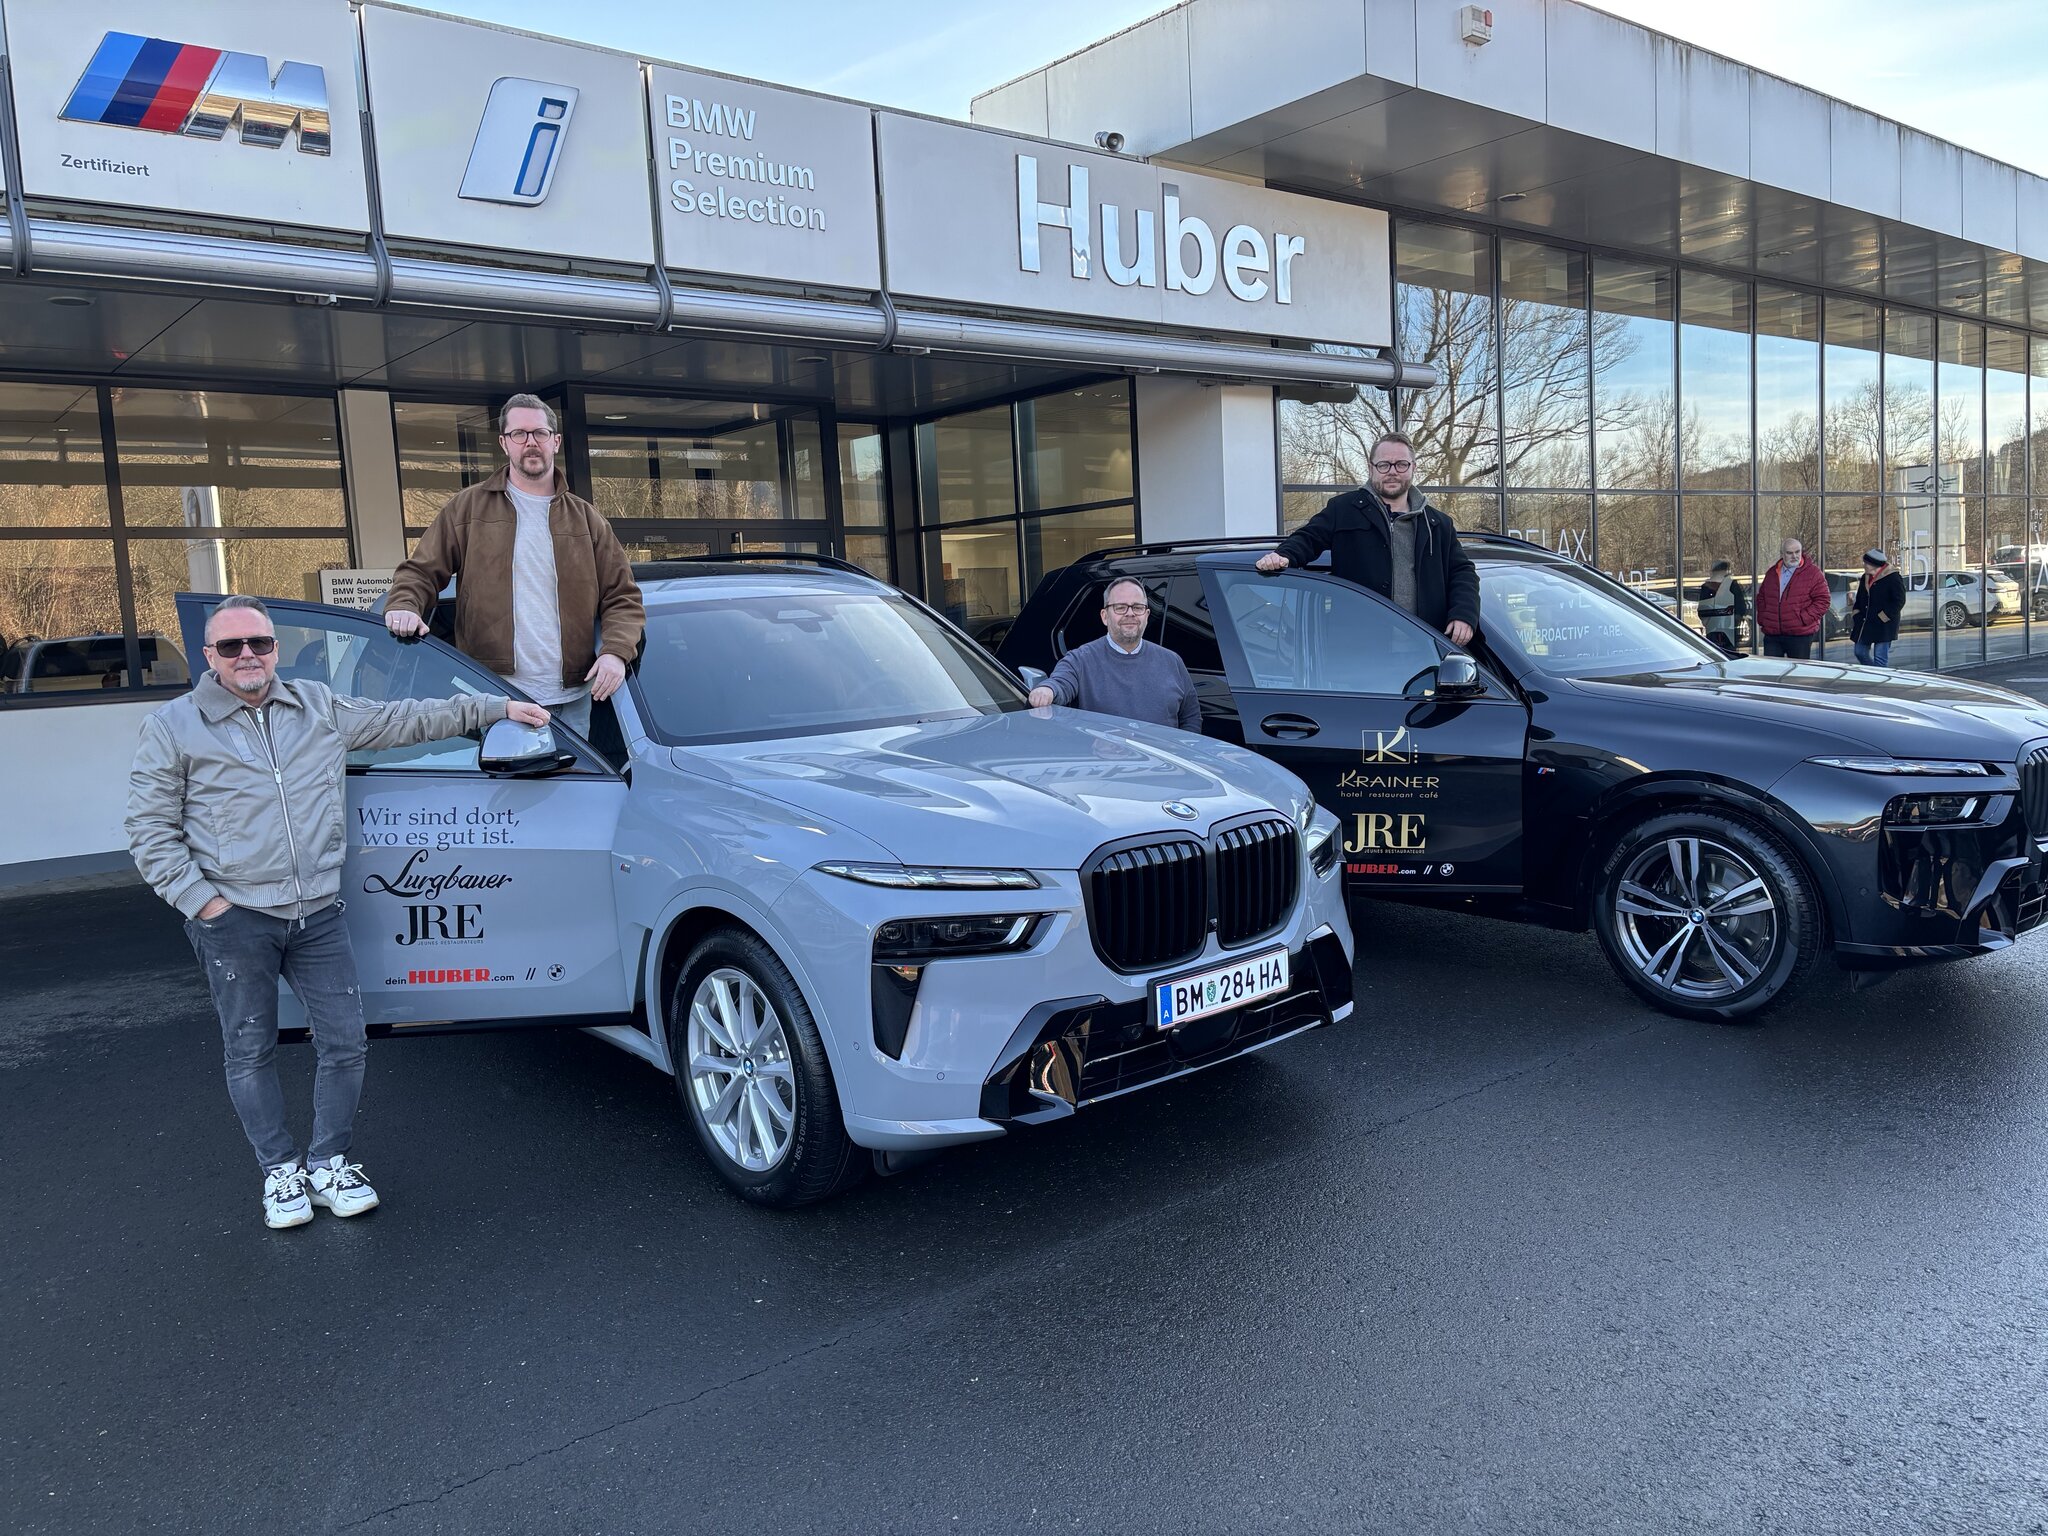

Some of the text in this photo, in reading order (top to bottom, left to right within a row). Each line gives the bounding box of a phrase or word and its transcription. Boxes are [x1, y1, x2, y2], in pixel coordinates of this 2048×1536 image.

[665, 94, 757, 140] BMW
[60, 153, 150, 176] Zertifiziert
[668, 136, 815, 191] Premium
[671, 179, 826, 231] Selection
[1016, 154, 1305, 304] Huber
[331, 577, 394, 586] BMW Automob
[332, 587, 354, 595] BMW
[336, 635, 353, 643] BM
[1336, 769, 1440, 789] KRAINER
[1340, 790, 1439, 799] hotel restaurant café
[358, 806, 520, 828] Wir sind dort,
[362, 826, 514, 851] wo es gut ist.
[1343, 813, 1426, 853] JRE
[363, 849, 513, 900] Lurgbauer
[395, 903, 484, 946] JRE
[1176, 958, 1283, 1016] BM 284 HA
[1163, 1009, 1170, 1018] A
